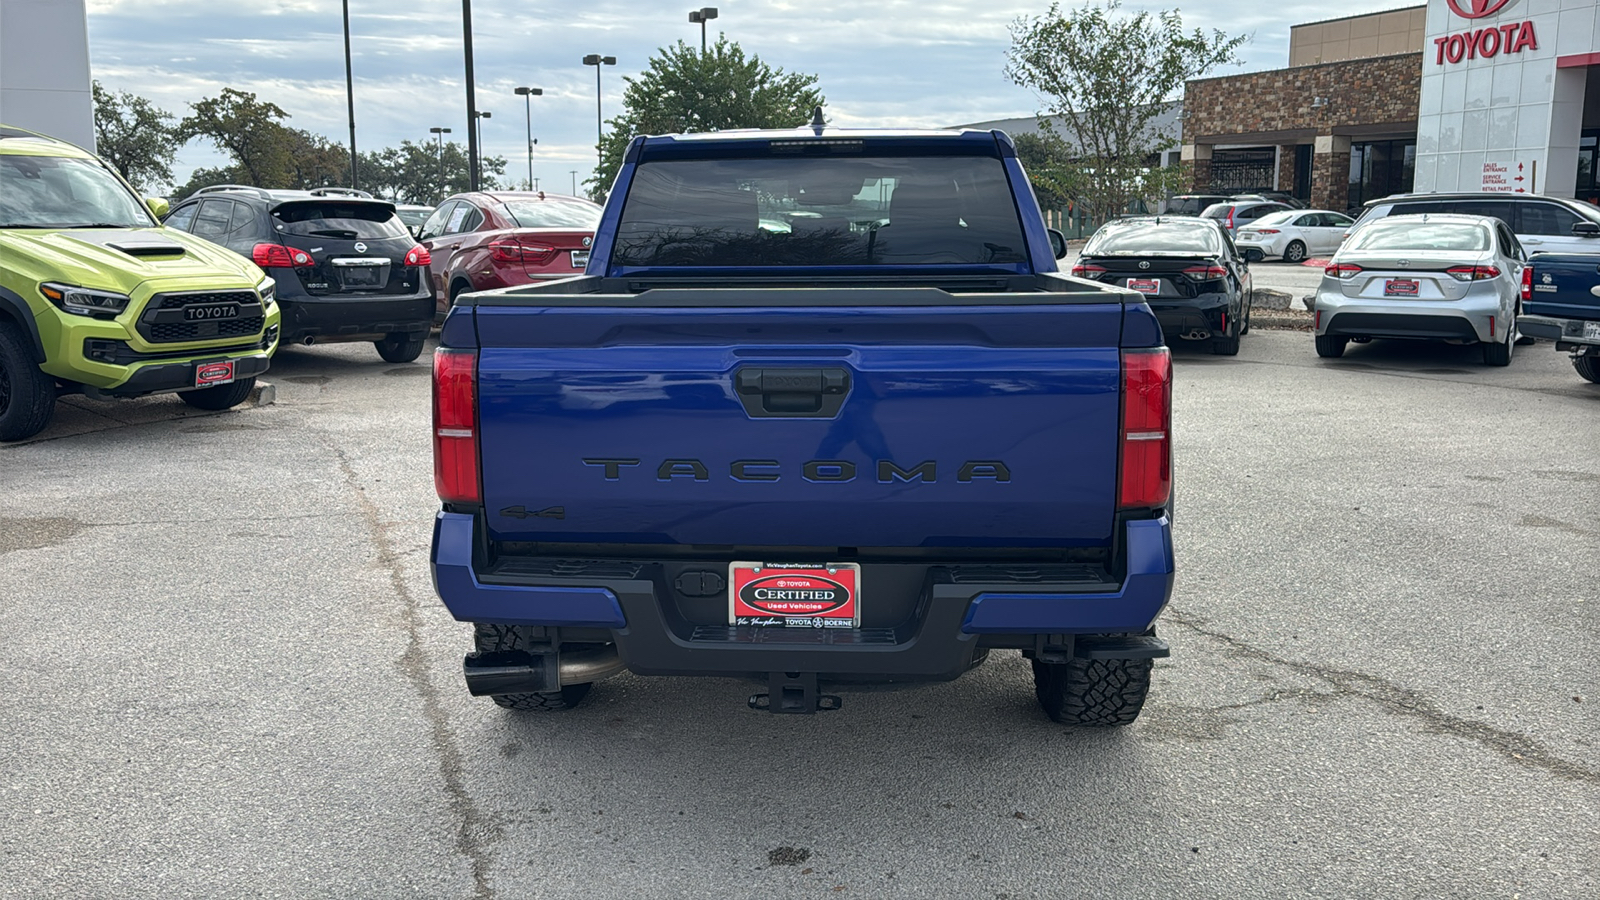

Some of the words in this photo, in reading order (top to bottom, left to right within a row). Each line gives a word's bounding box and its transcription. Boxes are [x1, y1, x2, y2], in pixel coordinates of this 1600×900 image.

[1434, 21, 1537, 65] TOYOTA
[188, 306, 236, 319] TOYOTA
[582, 458, 1011, 483] TACOMA
[754, 588, 835, 600] CERTIFIED
